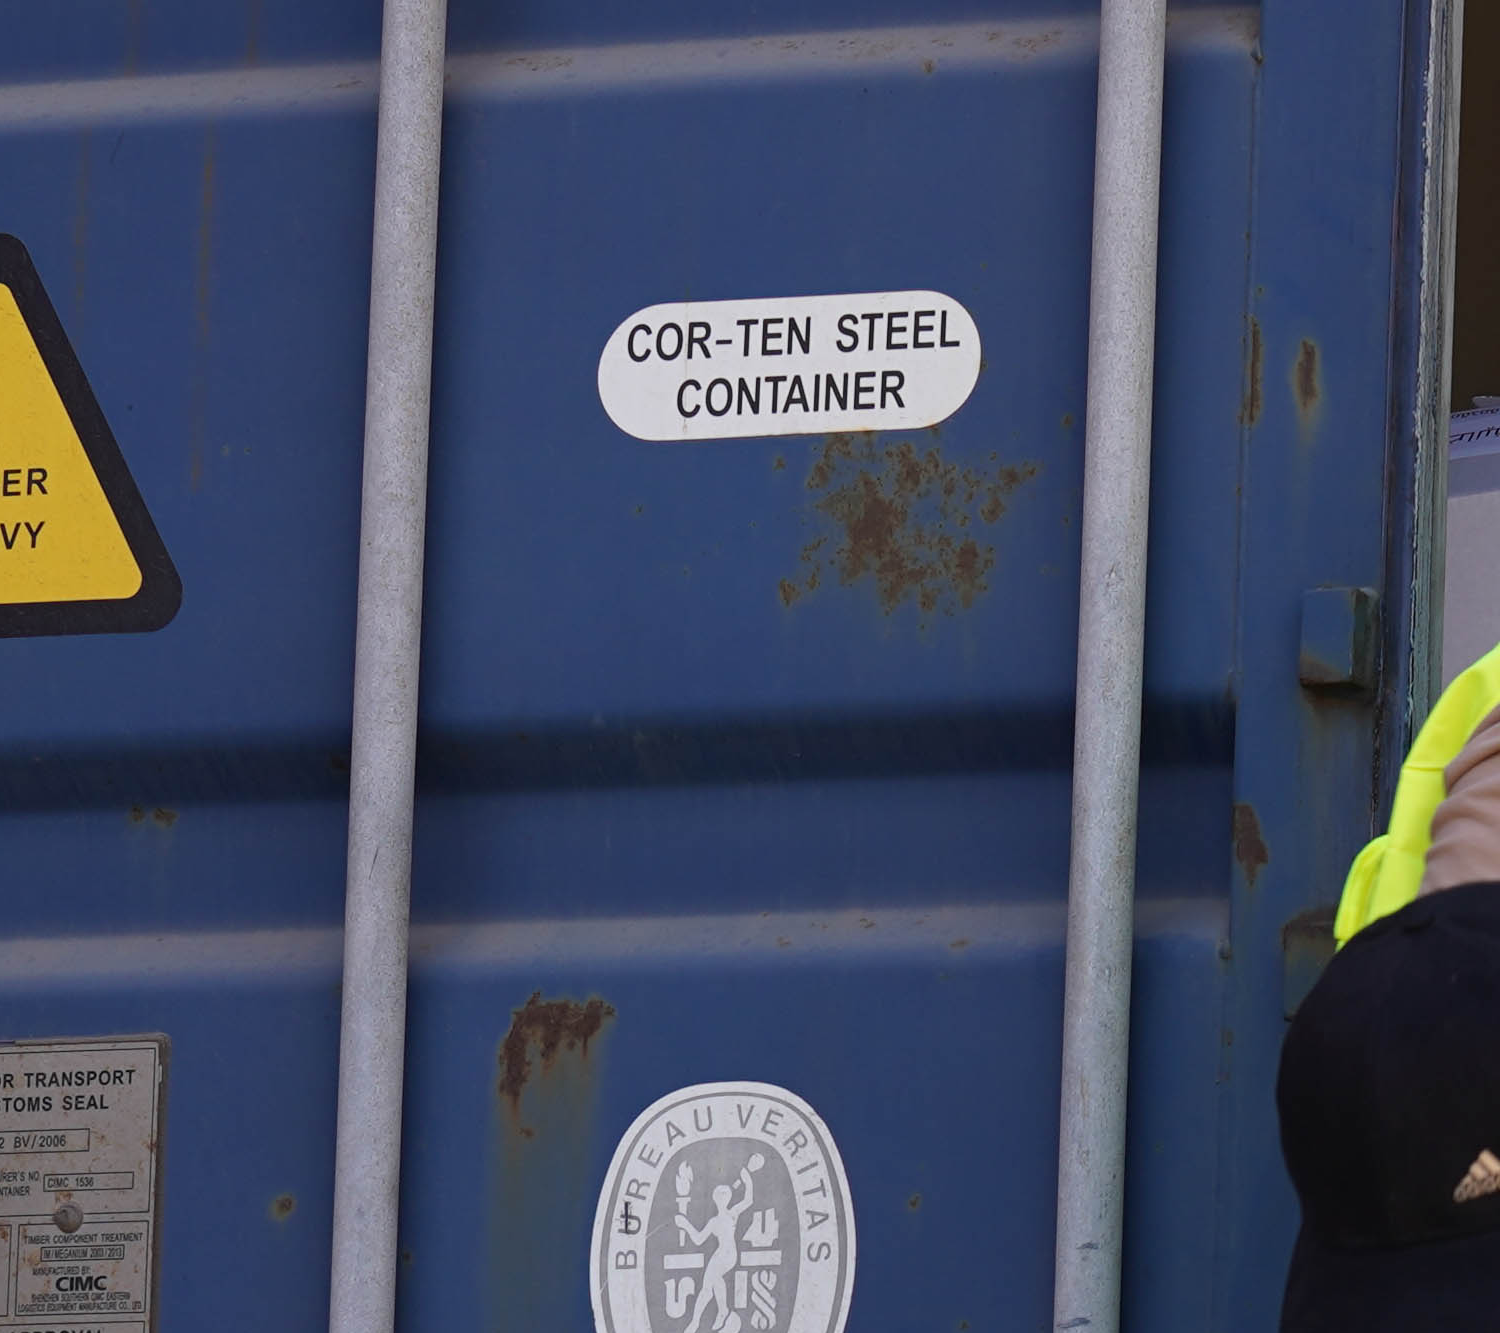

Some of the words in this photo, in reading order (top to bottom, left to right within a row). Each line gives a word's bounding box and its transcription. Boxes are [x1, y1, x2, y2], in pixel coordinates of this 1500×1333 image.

[627, 317, 811, 362] COR-TEN
[836, 310, 960, 353] STEEL
[677, 370, 906, 418] CONTAINER
[24, 1070, 136, 1088] TRANSPORT
[62, 1095, 109, 1110] SEAL
[615, 1105, 714, 1270] BUREAU
[736, 1104, 831, 1263] VERITAS
[56, 1276, 108, 1292] CIMC
